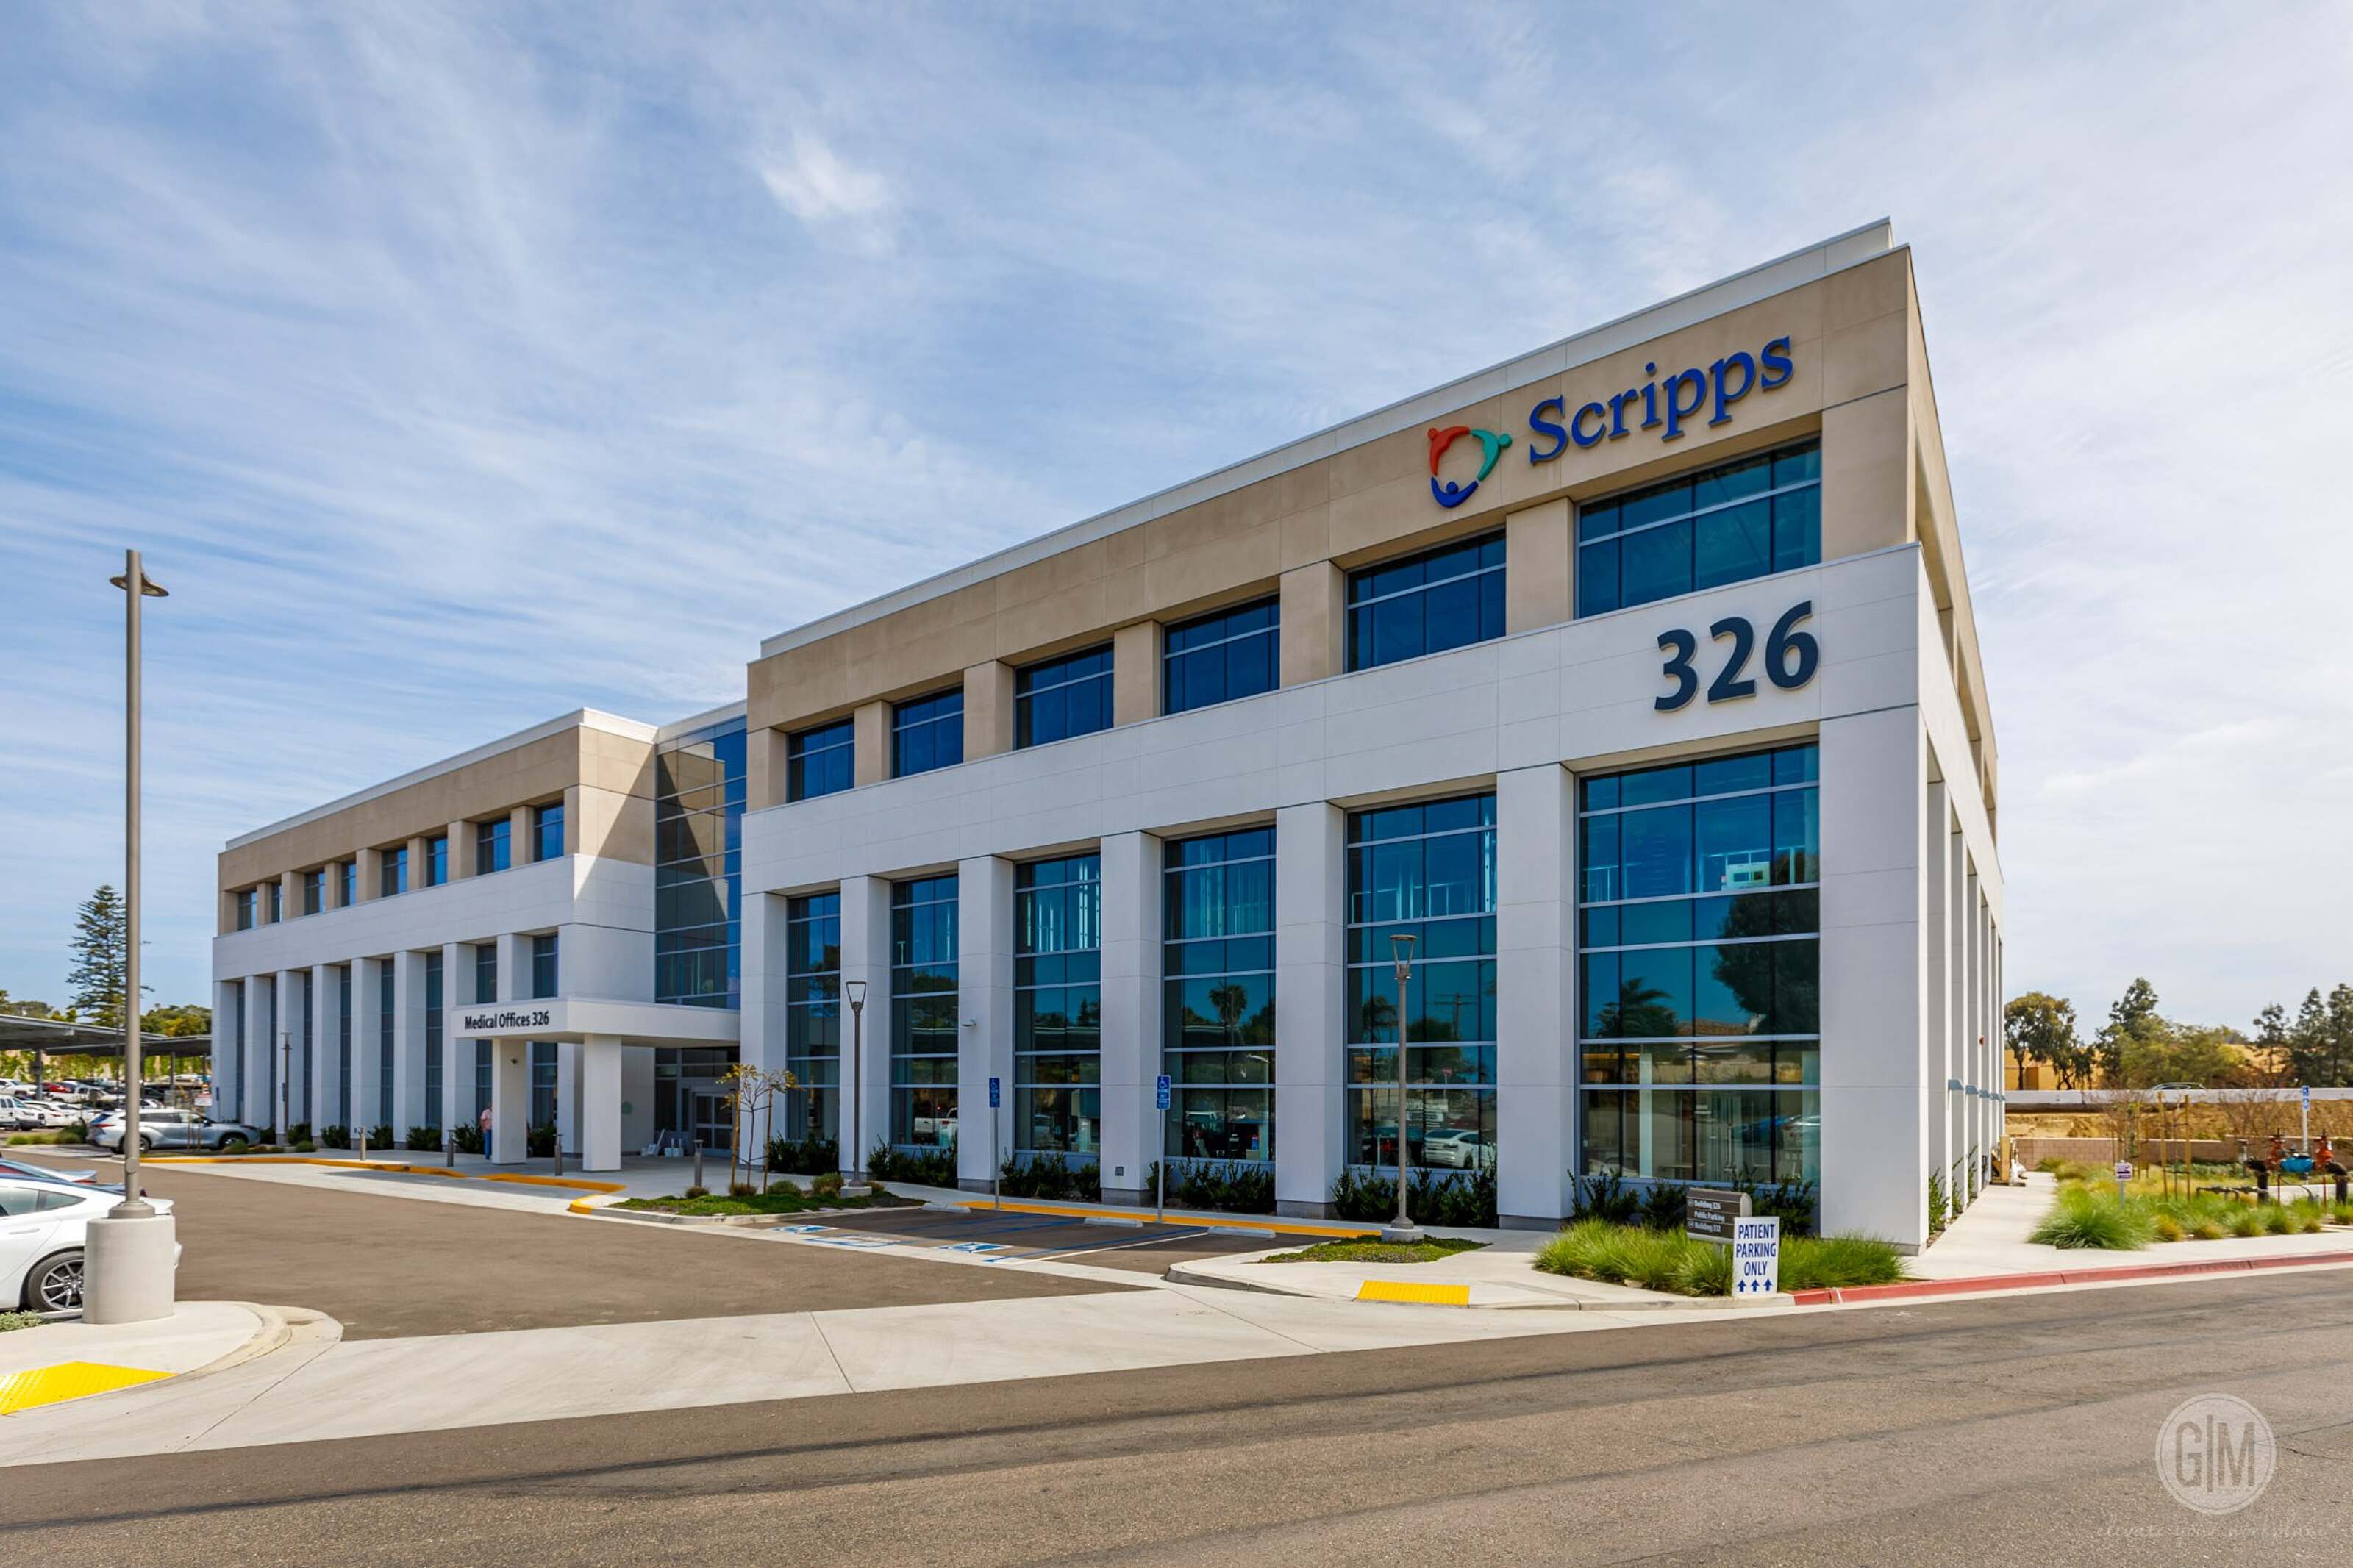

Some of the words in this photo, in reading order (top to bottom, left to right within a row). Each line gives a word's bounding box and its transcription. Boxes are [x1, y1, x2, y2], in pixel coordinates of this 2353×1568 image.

[1529, 336, 1794, 465] Scripps
[1654, 600, 1819, 712] 326
[465, 1014, 497, 1030] Medical
[499, 1012, 531, 1028] Offices
[532, 1010, 550, 1026] 326
[1738, 1223, 1775, 1239] PATIENT
[1736, 1242, 1777, 1258] PARKING
[1743, 1261, 1768, 1276] ONLY
